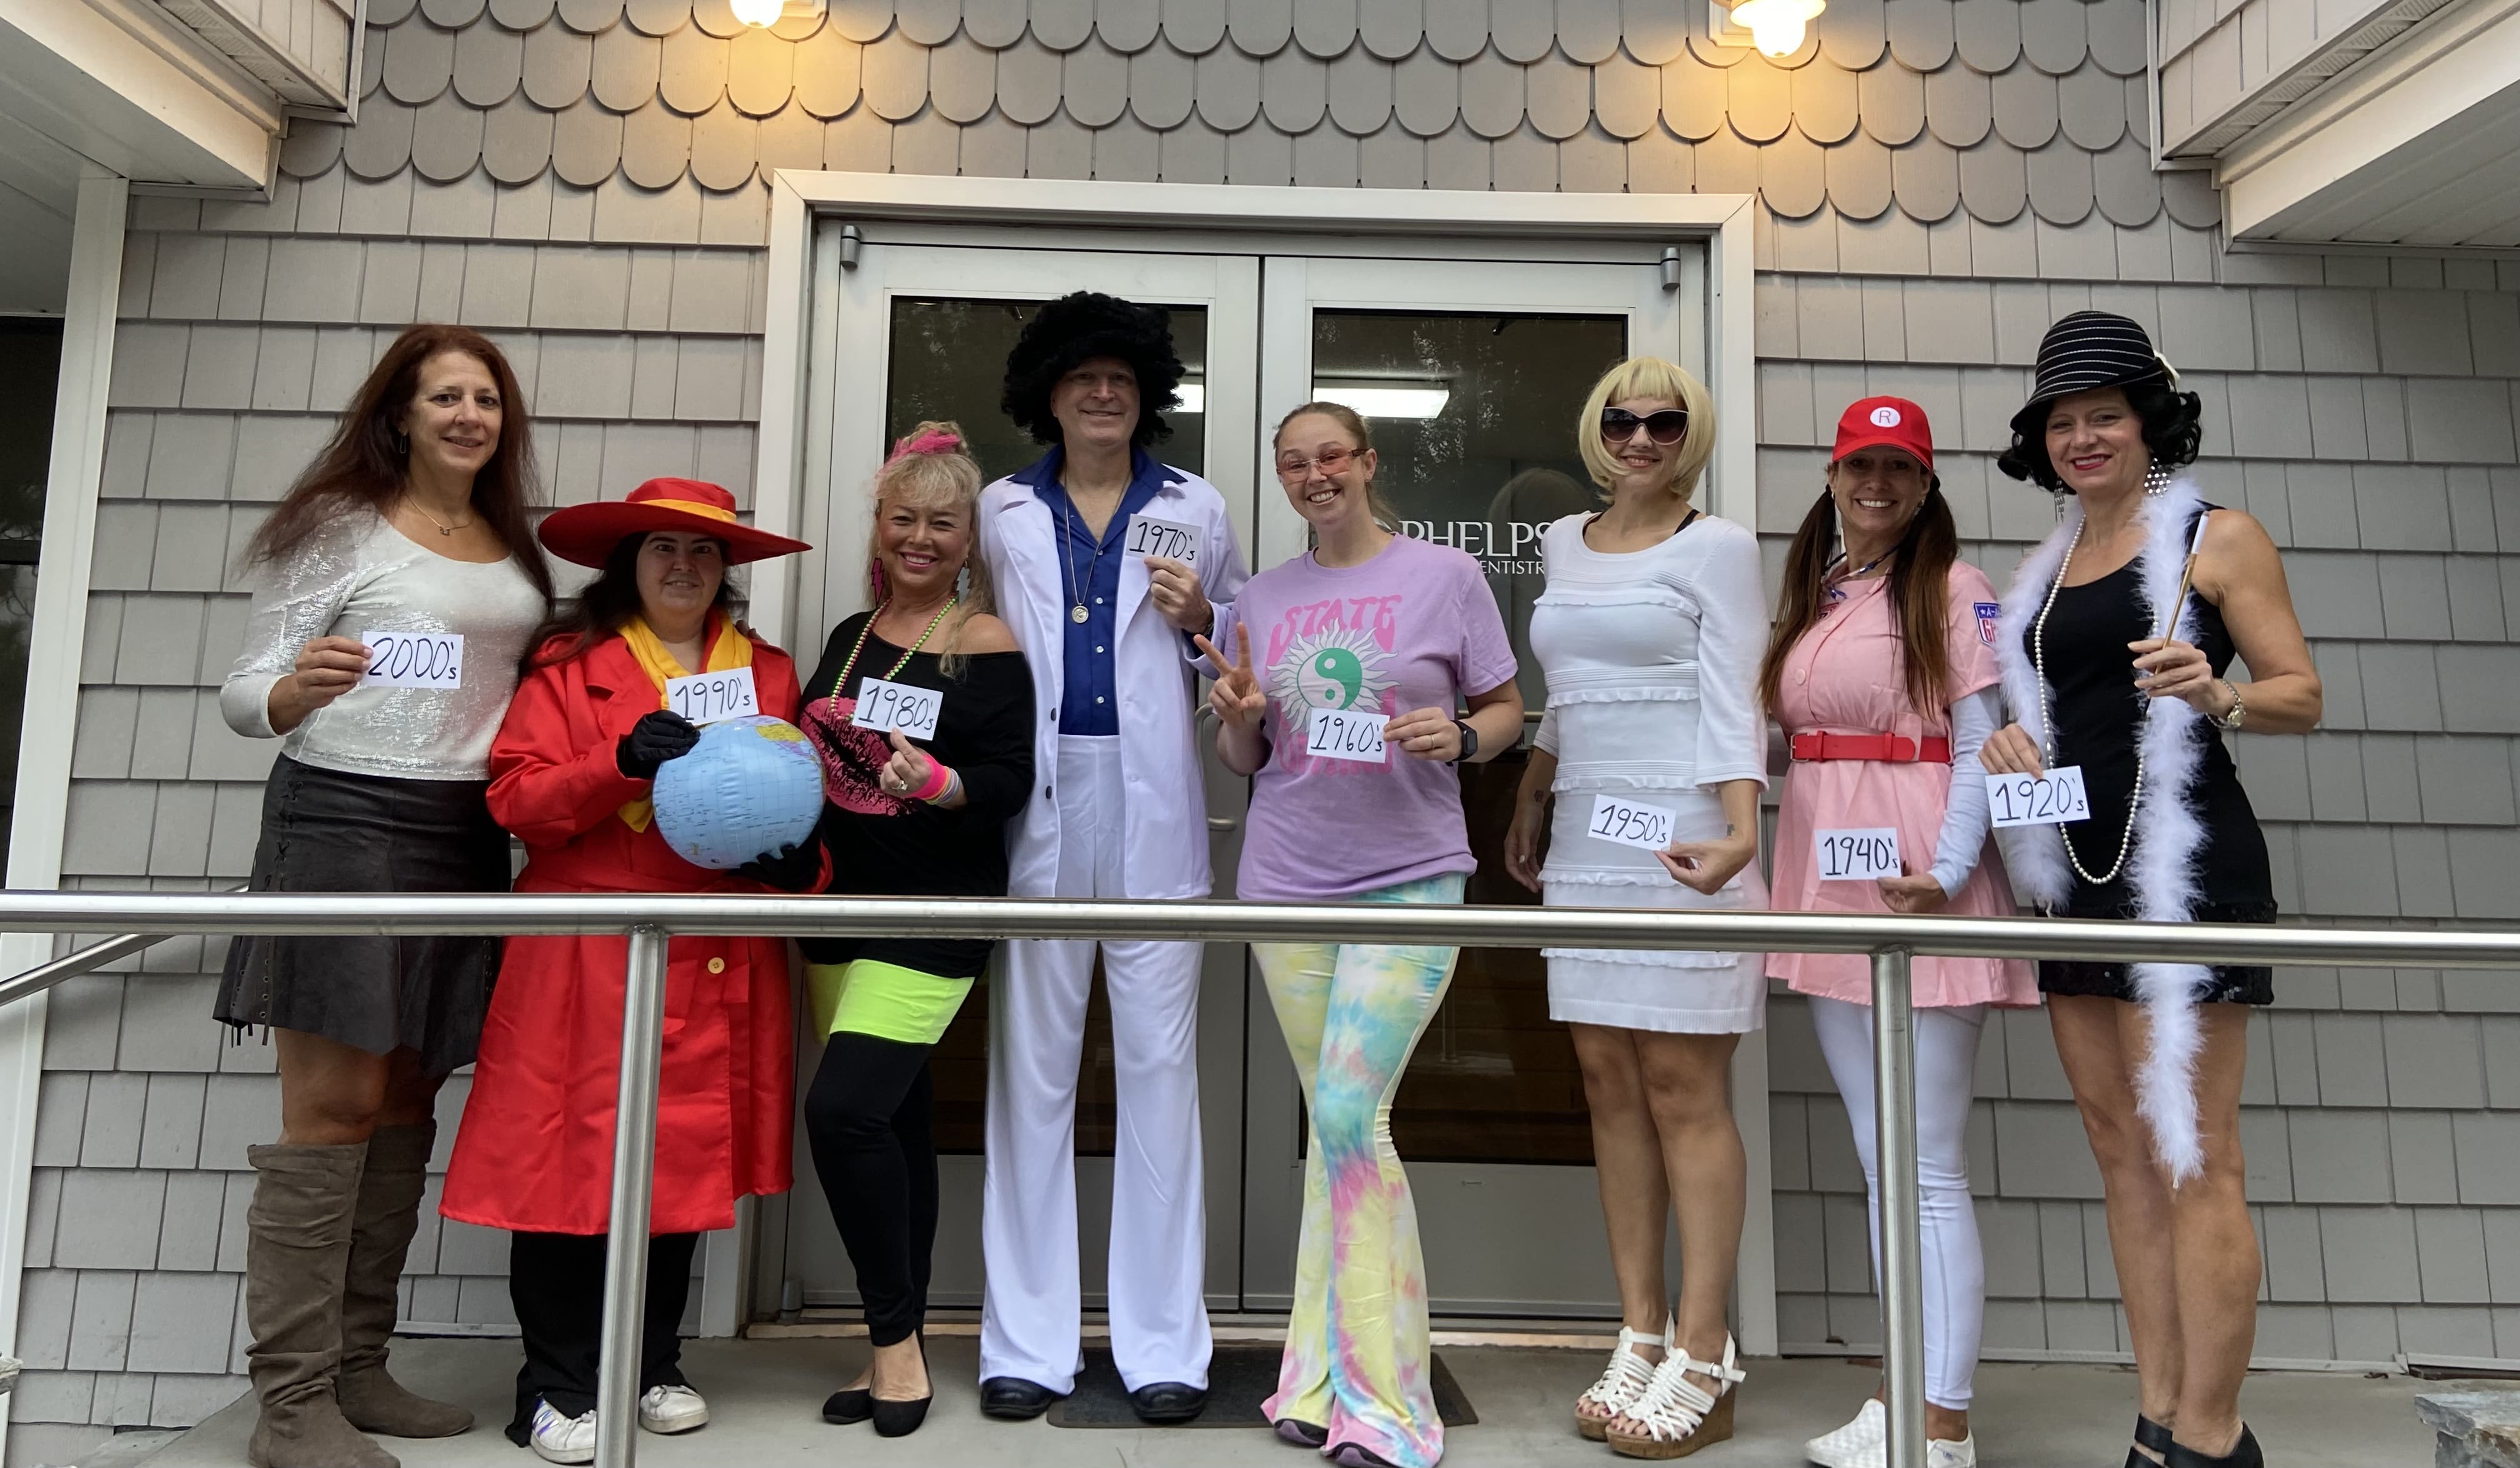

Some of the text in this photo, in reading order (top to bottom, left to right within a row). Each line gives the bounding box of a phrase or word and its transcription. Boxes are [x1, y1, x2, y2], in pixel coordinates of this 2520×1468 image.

[1878, 410, 1891, 424] R
[1129, 521, 1196, 561] 1970's
[1479, 560, 1545, 574] ENTISTR
[1265, 594, 1402, 676] STATE
[368, 637, 457, 681] 2000's
[675, 677, 751, 721] 1990's
[858, 686, 934, 731] 1980's
[1310, 715, 1382, 752] 1960's
[1995, 777, 2084, 821] 1920's
[1591, 804, 1666, 843] 1950's
[1824, 836, 1898, 876] 1940's
